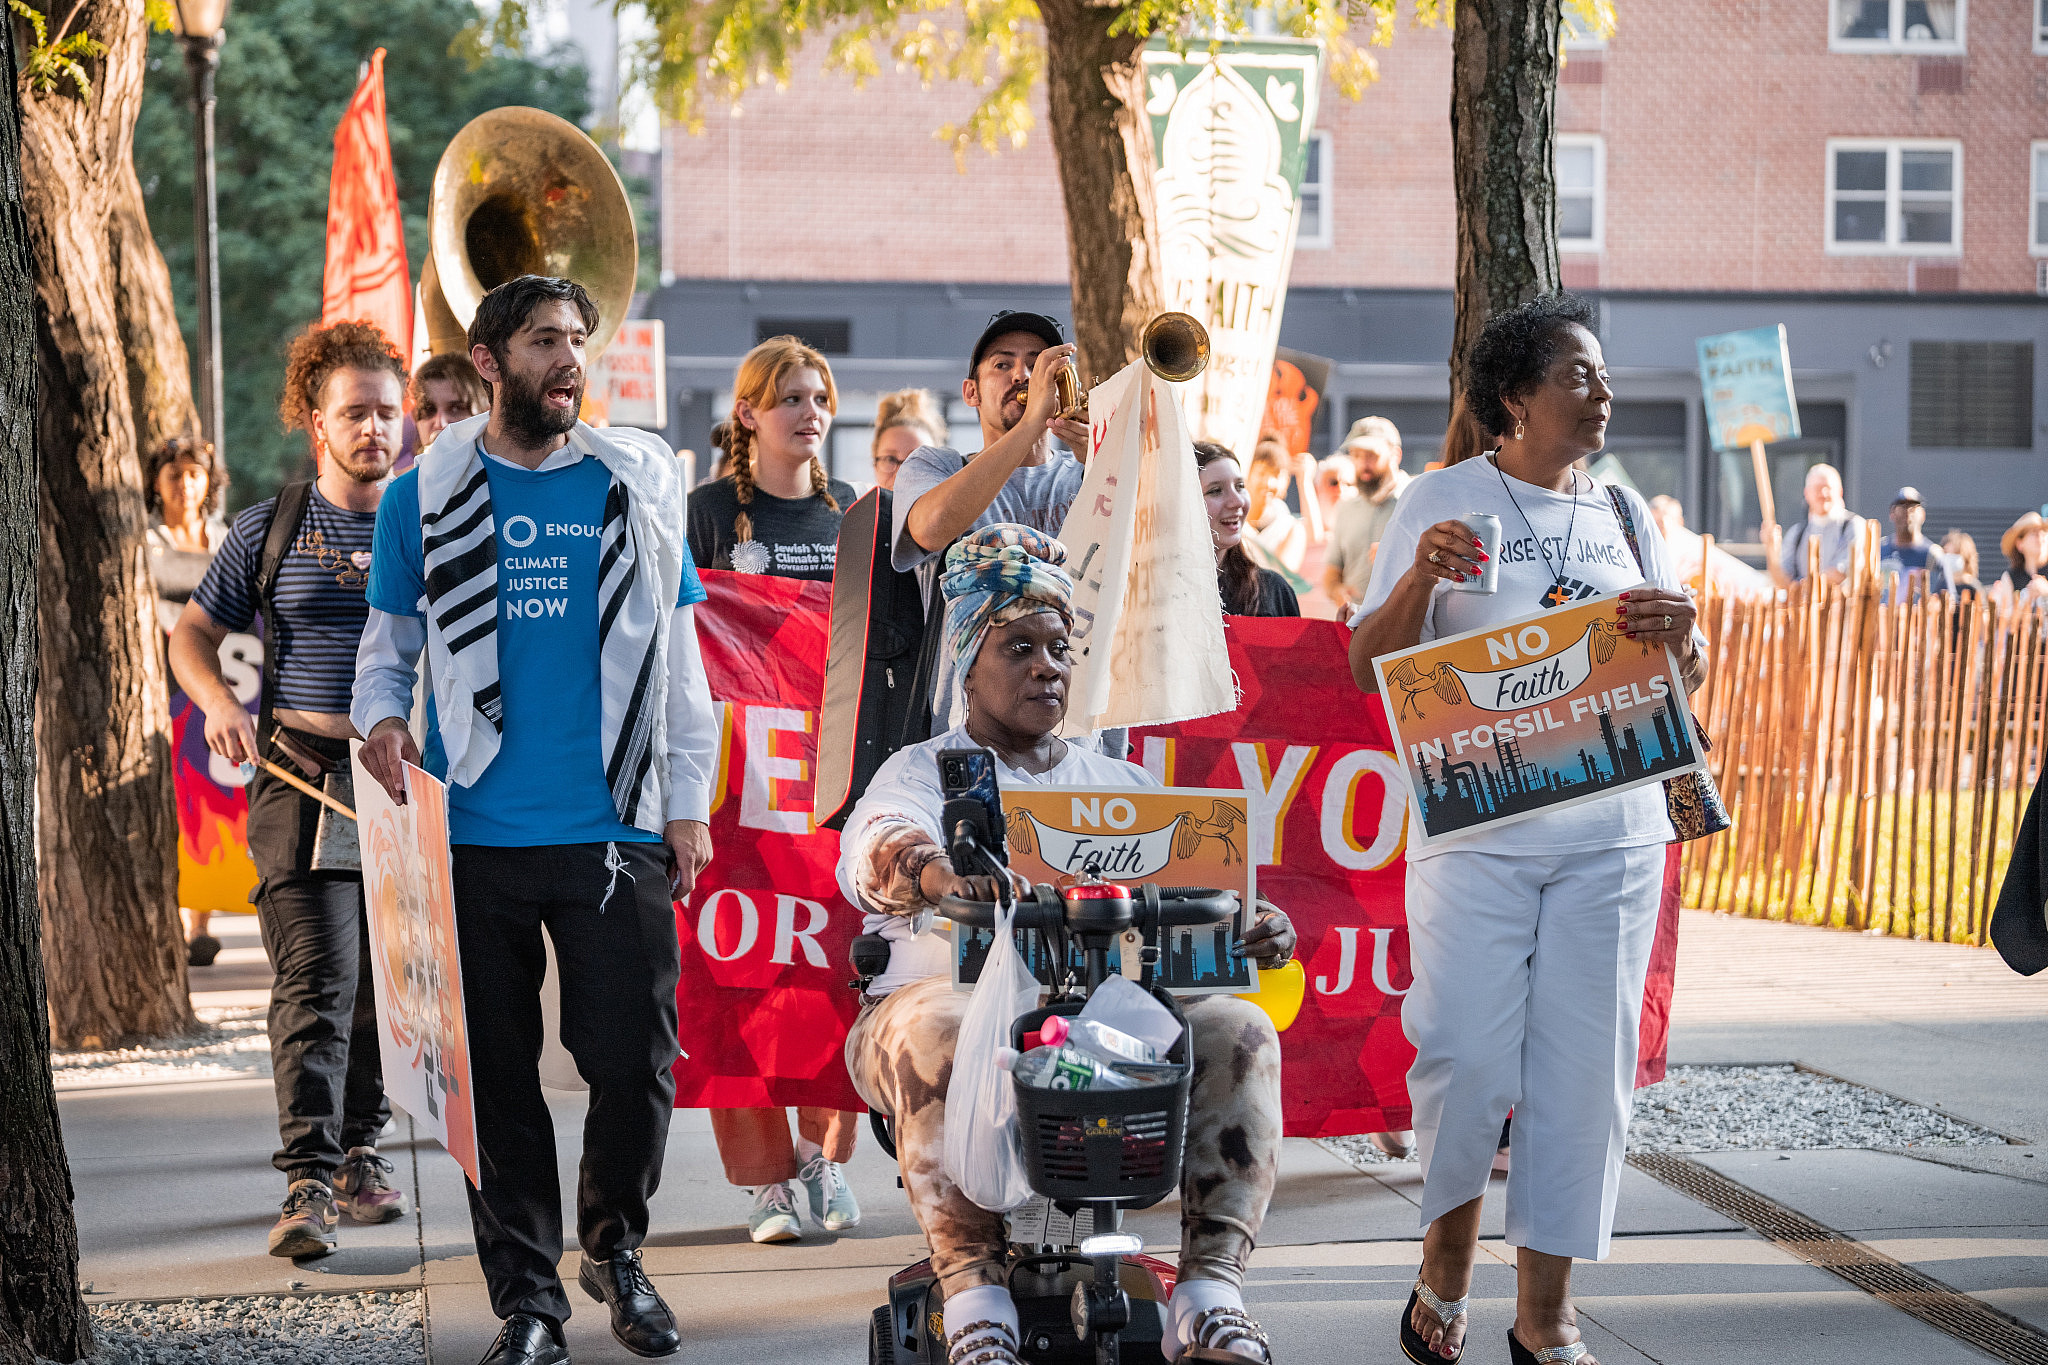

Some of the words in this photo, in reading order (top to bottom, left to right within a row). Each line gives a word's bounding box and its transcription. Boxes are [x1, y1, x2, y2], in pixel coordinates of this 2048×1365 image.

[504, 556, 568, 570] CLIMATE
[774, 543, 811, 554] Jewish
[775, 553, 820, 564] Climate
[1499, 537, 1537, 565] RISE
[1541, 537, 1572, 562] ST.
[1576, 538, 1628, 569] JAMES
[506, 577, 568, 592] JUSTICE
[506, 598, 568, 620] NOW
[1486, 625, 1550, 666] NO
[1495, 658, 1569, 709] Faith
[1409, 738, 1445, 767] IN
[1450, 707, 1565, 755] FOSSIL
[1568, 674, 1669, 724] FUELS
[1071, 797, 1137, 830] NO
[1065, 838, 1145, 875] Faith
[683, 888, 831, 969] OR
[1085, 1127, 1123, 1137] GOLDEN
